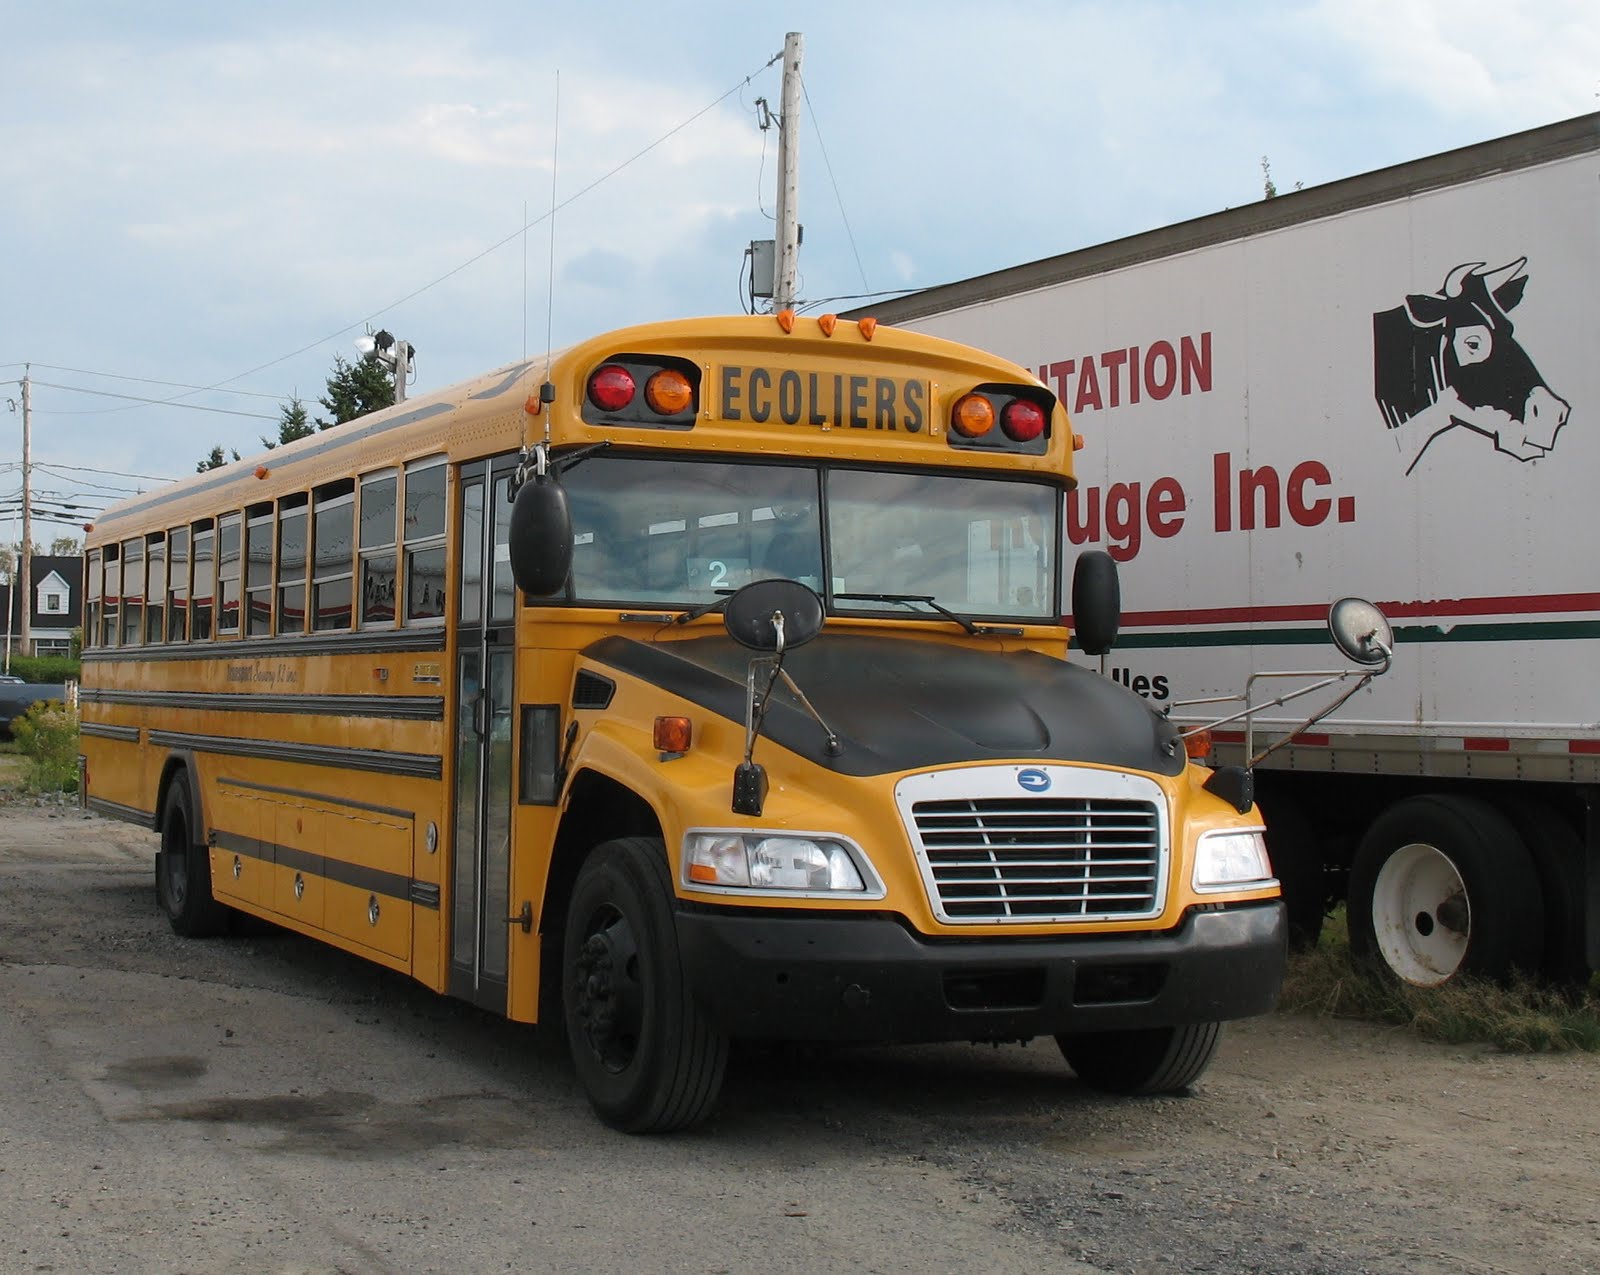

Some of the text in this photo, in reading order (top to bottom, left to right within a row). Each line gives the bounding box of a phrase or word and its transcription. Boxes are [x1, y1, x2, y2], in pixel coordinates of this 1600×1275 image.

[721, 366, 923, 433] ECOLIERS
[1066, 451, 1356, 562] uge Inc.
[708, 560, 730, 588] 2
